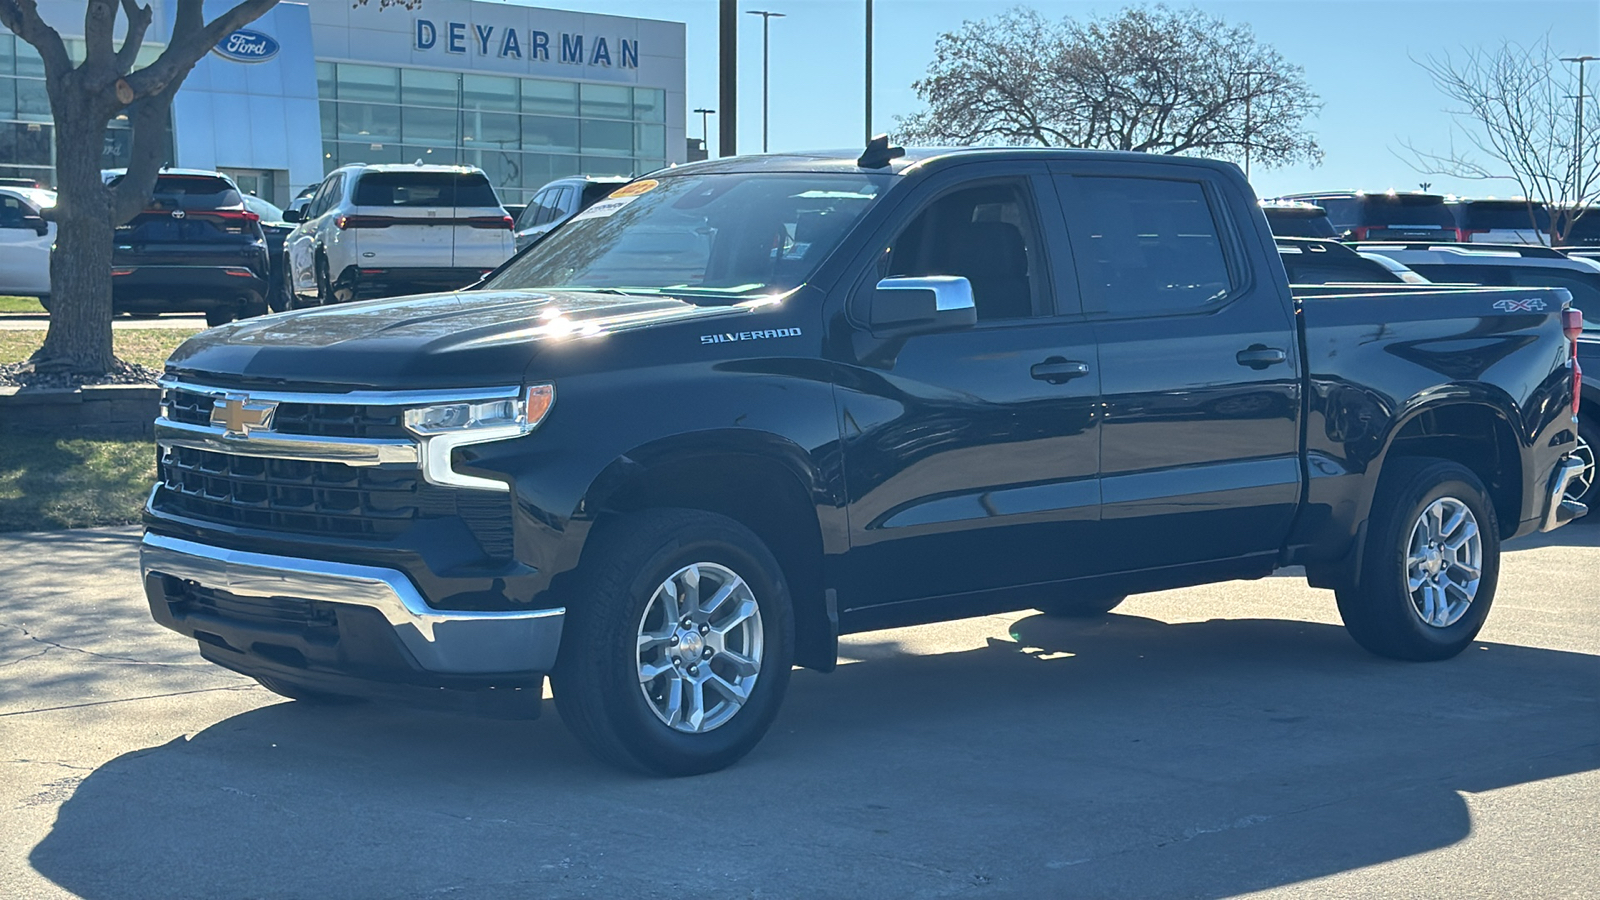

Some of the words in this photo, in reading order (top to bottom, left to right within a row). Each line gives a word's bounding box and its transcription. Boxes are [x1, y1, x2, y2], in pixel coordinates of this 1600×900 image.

[227, 33, 267, 54] Ford
[415, 18, 639, 68] DEYARMAN
[700, 326, 802, 345] SILVERADO
